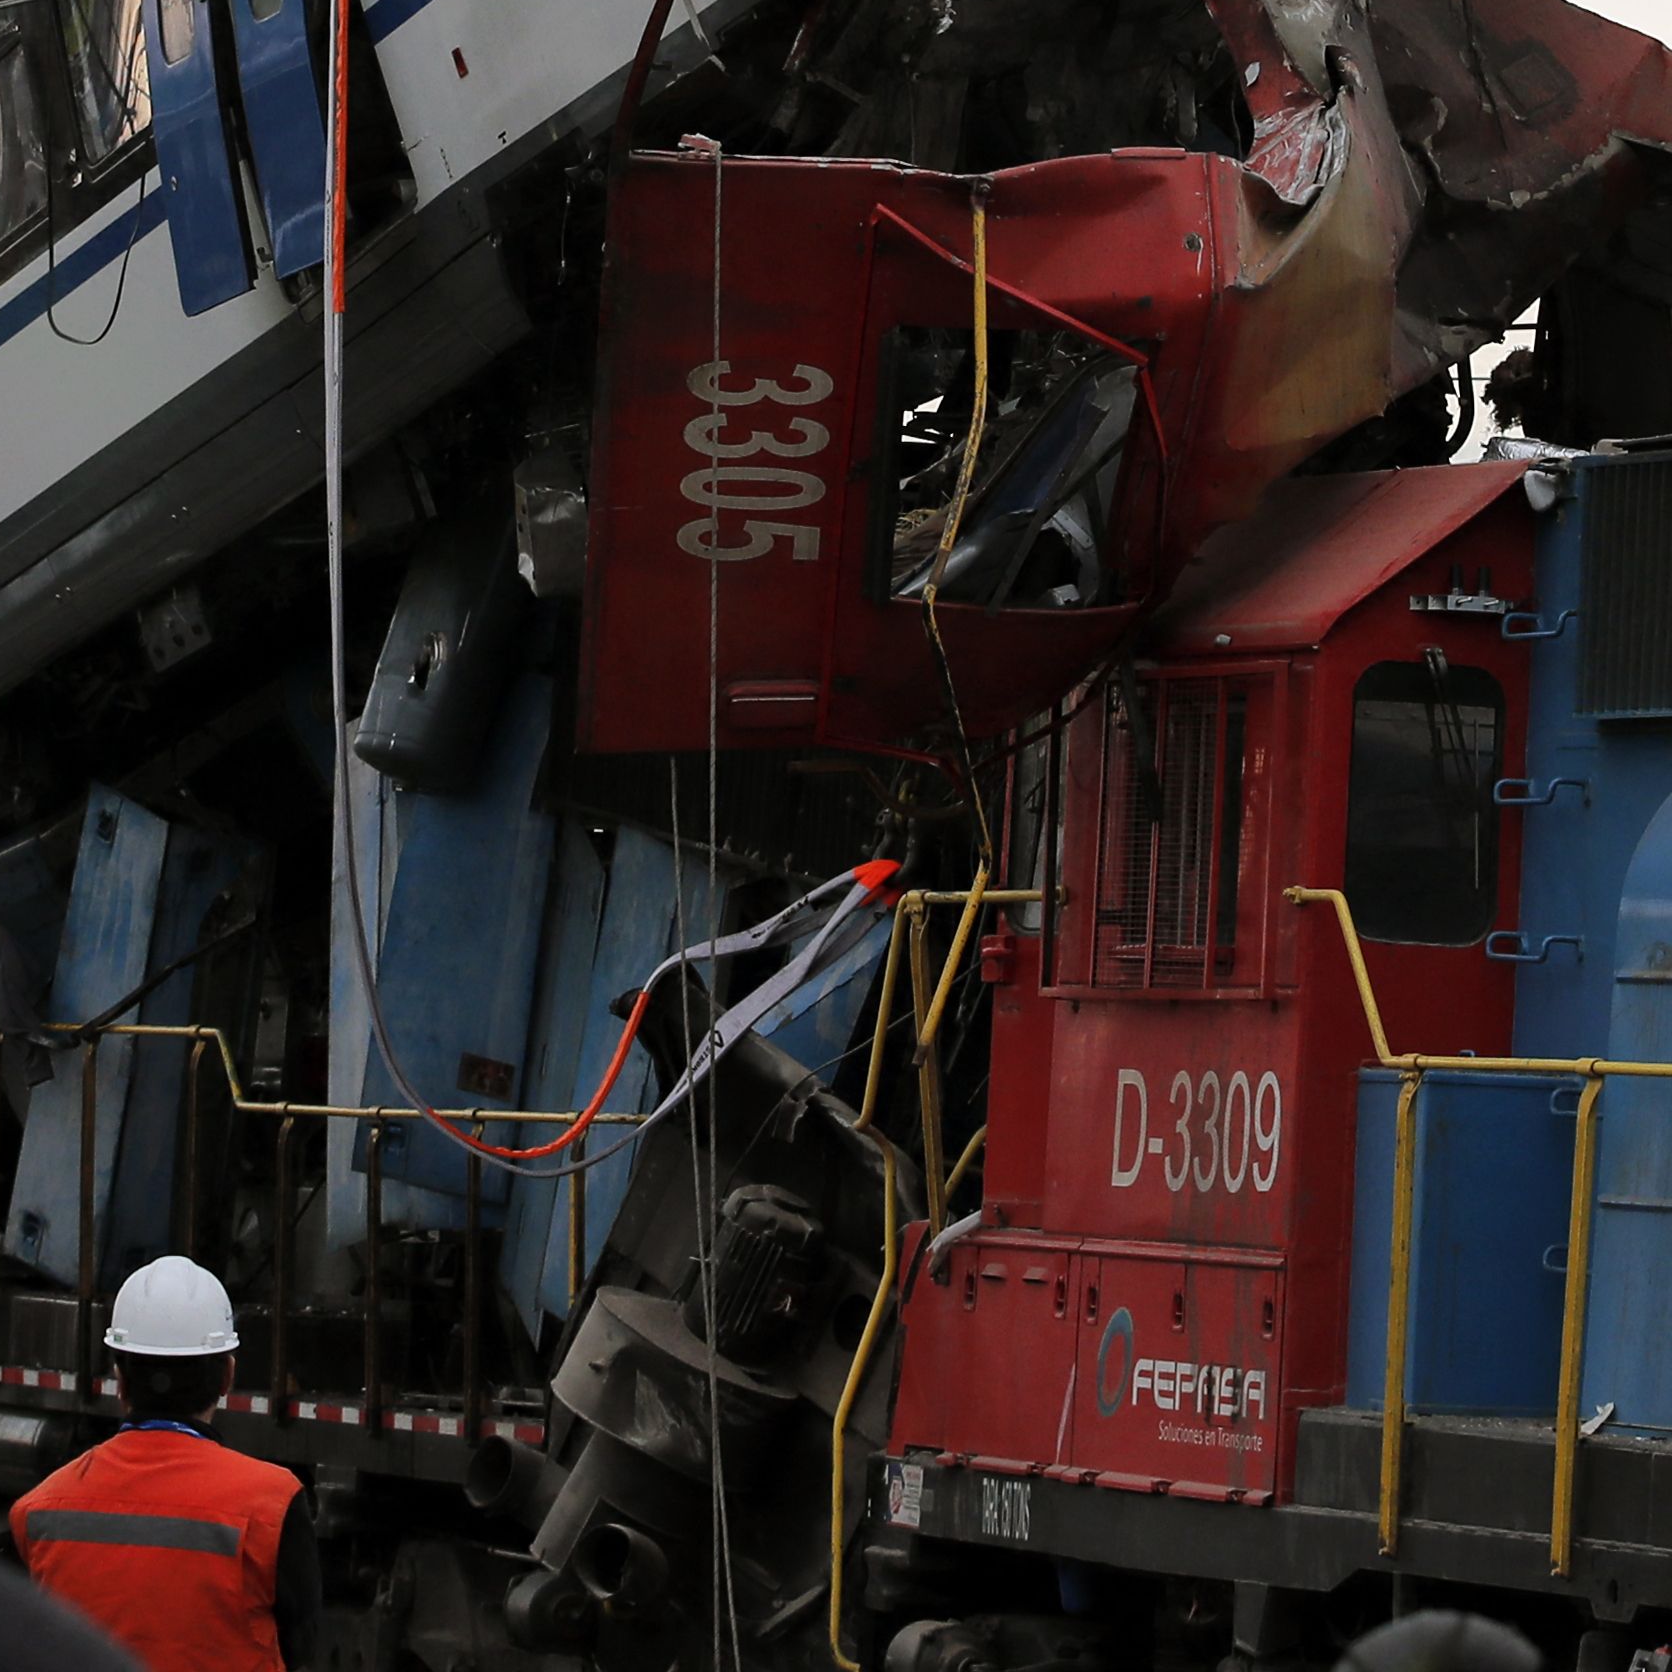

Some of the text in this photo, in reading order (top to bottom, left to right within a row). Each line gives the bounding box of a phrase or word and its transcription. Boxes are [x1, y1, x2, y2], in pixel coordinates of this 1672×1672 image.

[676, 359, 835, 561] 3305
[1110, 1068, 1282, 1194] D-3309
[1131, 1358, 1266, 1420] FEPASA
[1158, 1419, 1264, 1454] Soluciones en Transporte
